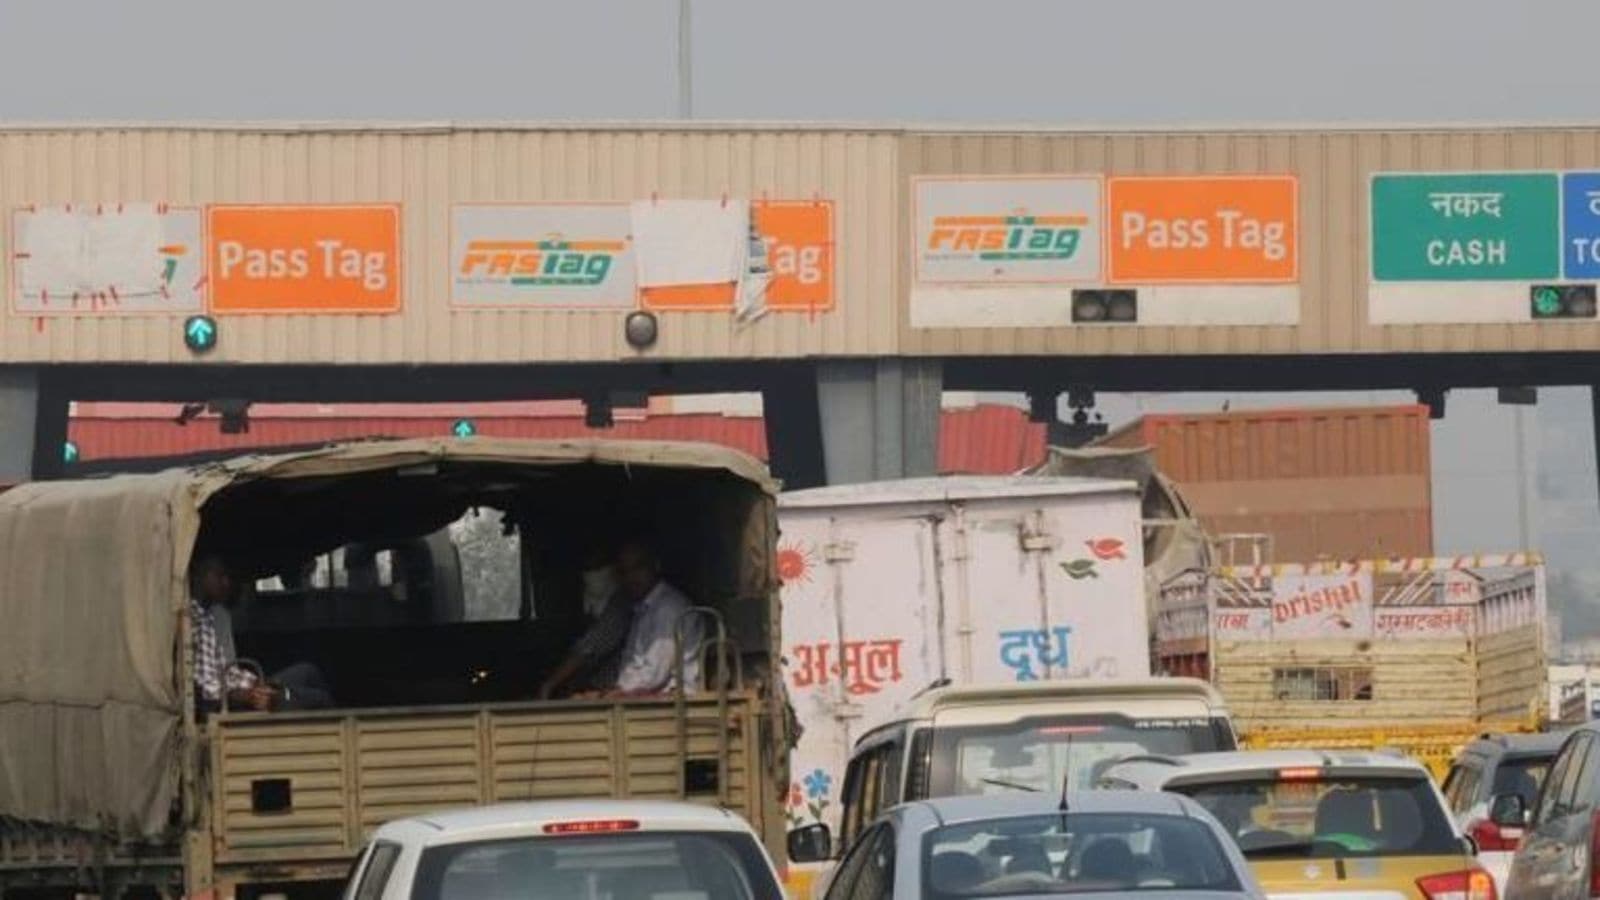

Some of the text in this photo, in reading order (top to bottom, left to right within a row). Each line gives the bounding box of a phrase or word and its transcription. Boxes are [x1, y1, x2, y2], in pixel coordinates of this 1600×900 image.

[1428, 192, 1504, 217] नकद
[766, 236, 822, 284] ag
[1121, 210, 1286, 261] Pass Tag
[1427, 240, 1506, 265] CASH
[217, 241, 308, 280] Pass
[316, 239, 388, 291] Tag
[793, 638, 903, 695] अमूल
[998, 625, 1072, 682] दूध
